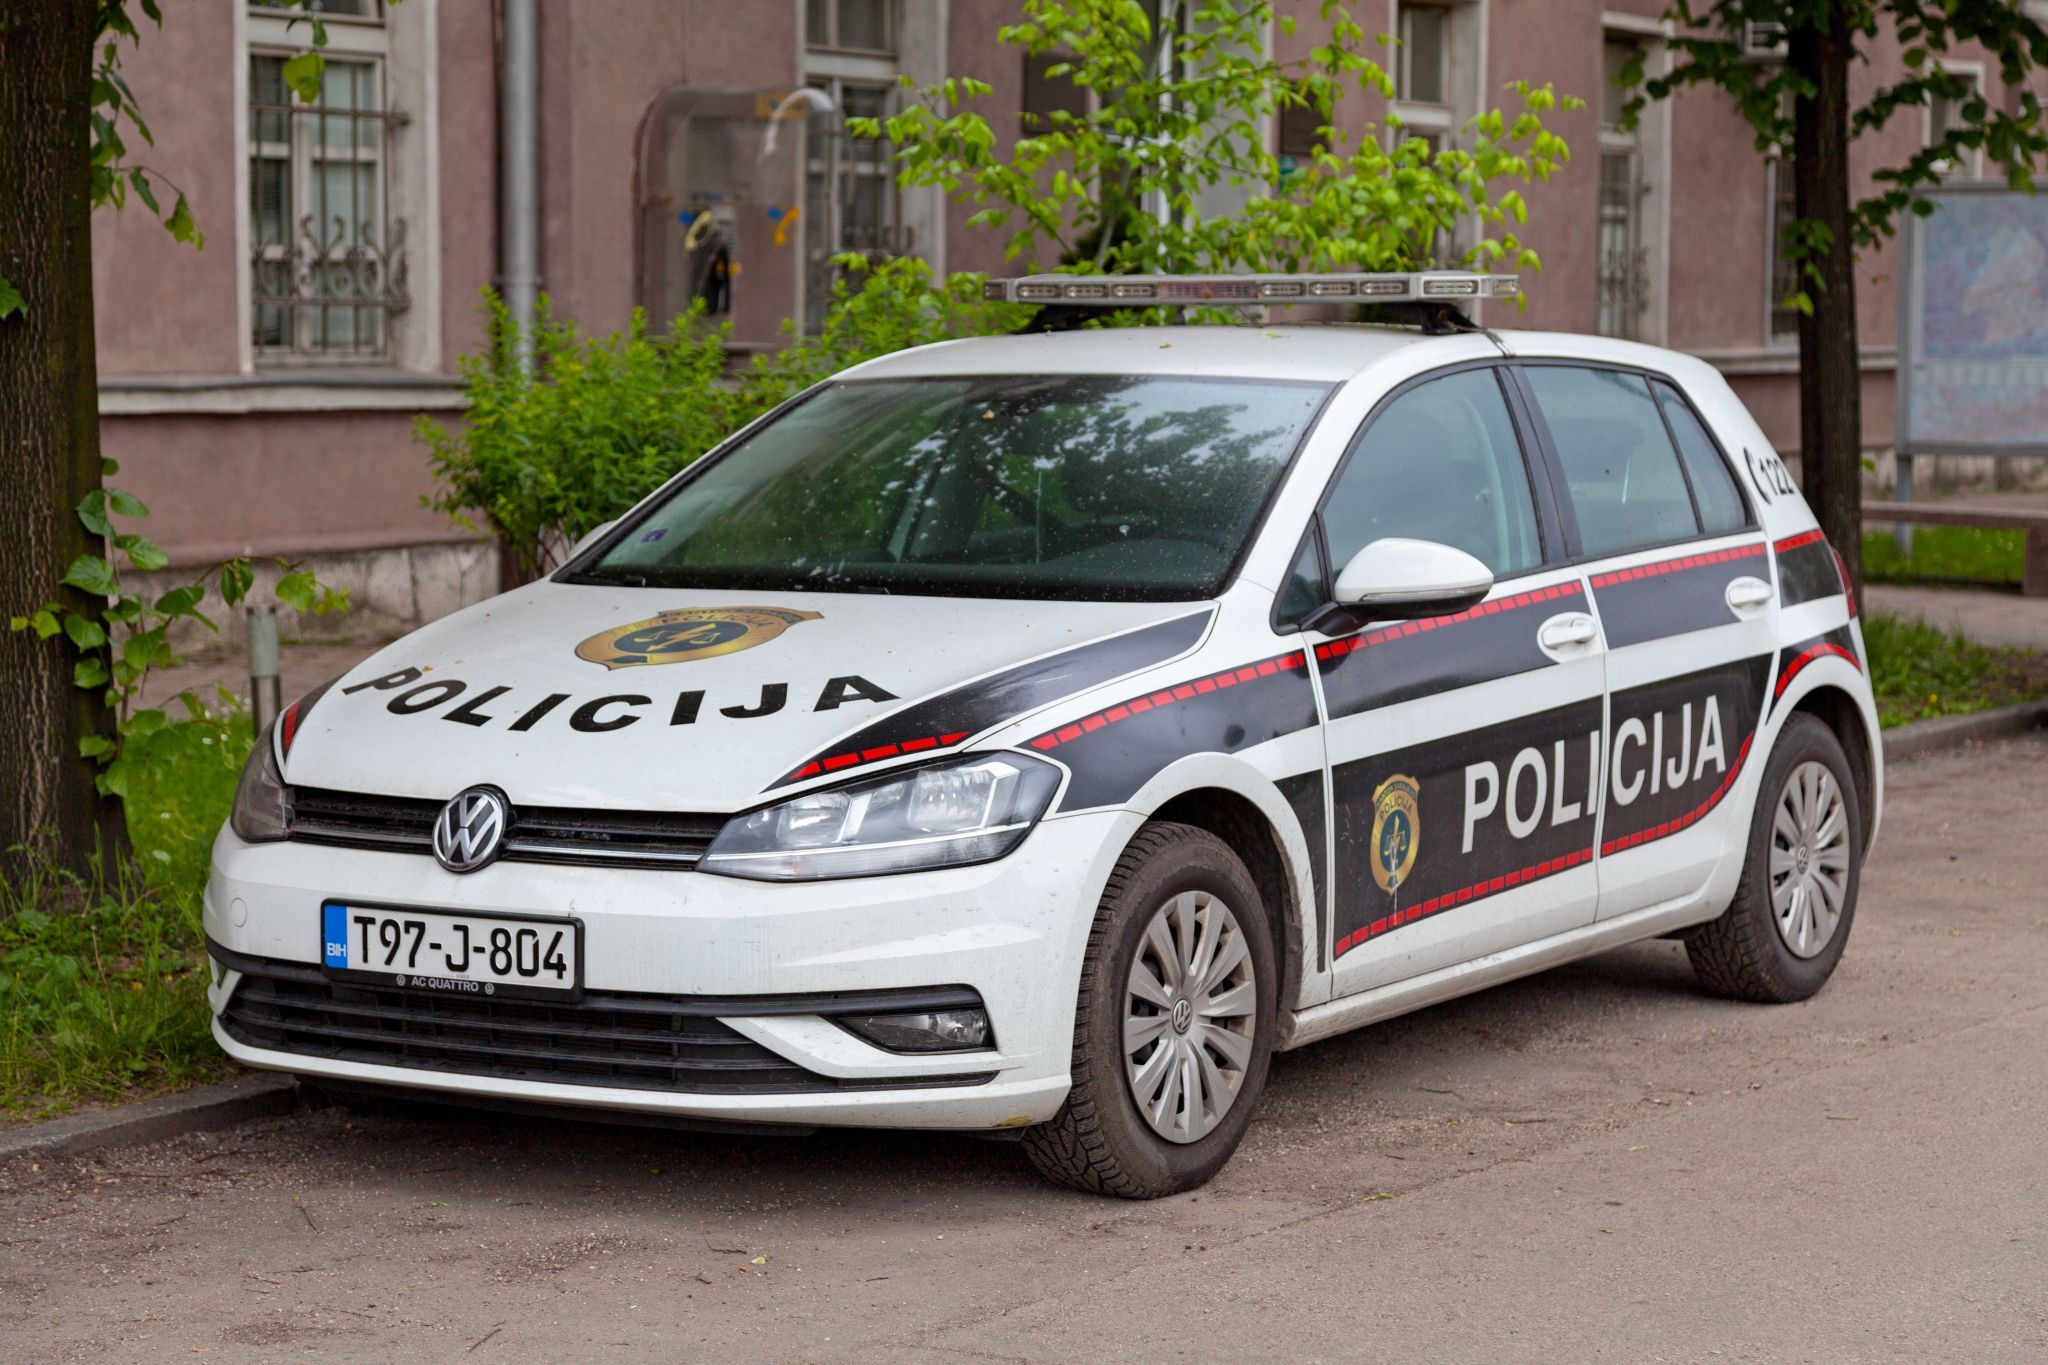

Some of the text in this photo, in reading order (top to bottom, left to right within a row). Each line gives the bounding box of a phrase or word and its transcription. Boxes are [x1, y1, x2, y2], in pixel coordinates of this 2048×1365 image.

[1759, 457, 1795, 495] 122
[661, 613, 776, 627] POLICIJA
[341, 666, 903, 732] POLICIJA
[1462, 695, 1726, 854] POLICIJA
[1379, 795, 1412, 821] POLICIJA
[327, 943, 347, 957] BIH
[353, 916, 567, 979] T97-J-804
[411, 976, 479, 992] AC QUATTRO
